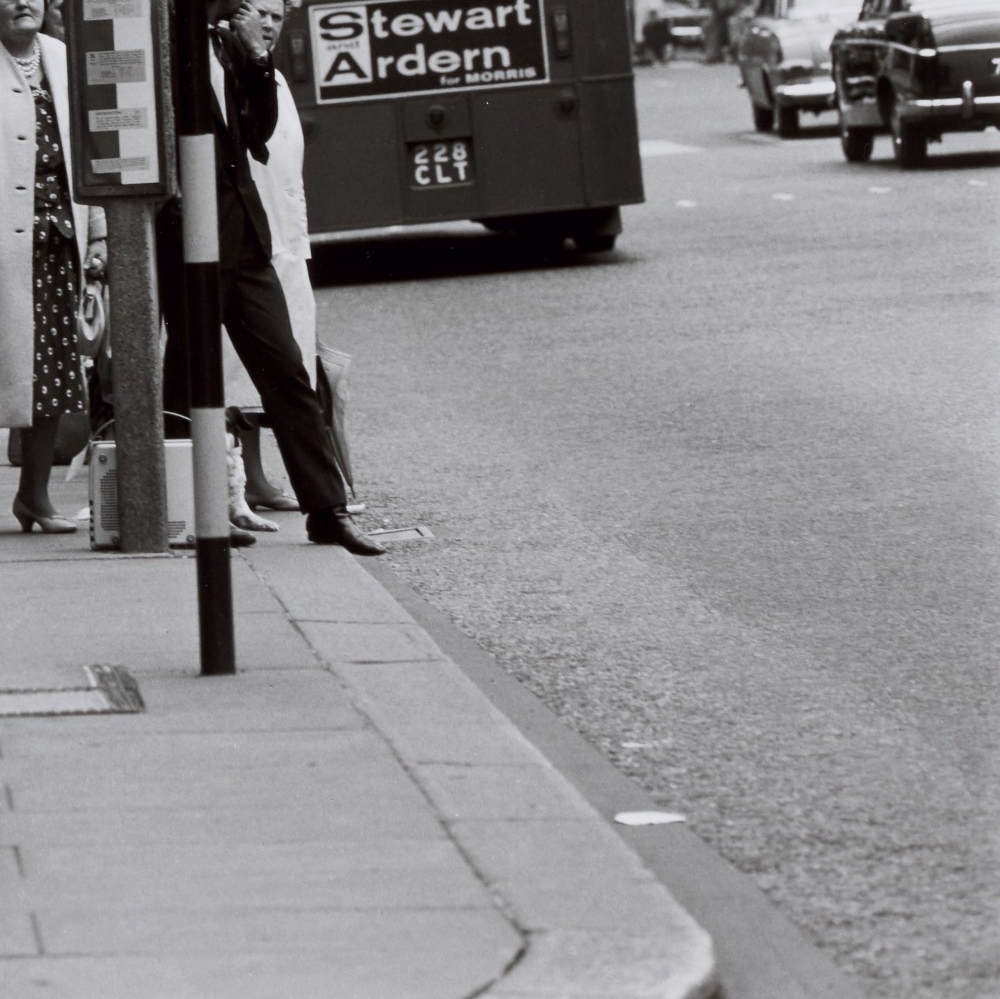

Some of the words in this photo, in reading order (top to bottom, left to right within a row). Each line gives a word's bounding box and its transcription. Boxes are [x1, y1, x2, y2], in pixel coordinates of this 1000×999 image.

[323, 43, 512, 82] Ardern
[465, 67, 537, 83] MORRIS
[414, 142, 468, 164] 228
[414, 161, 468, 185] CLT
